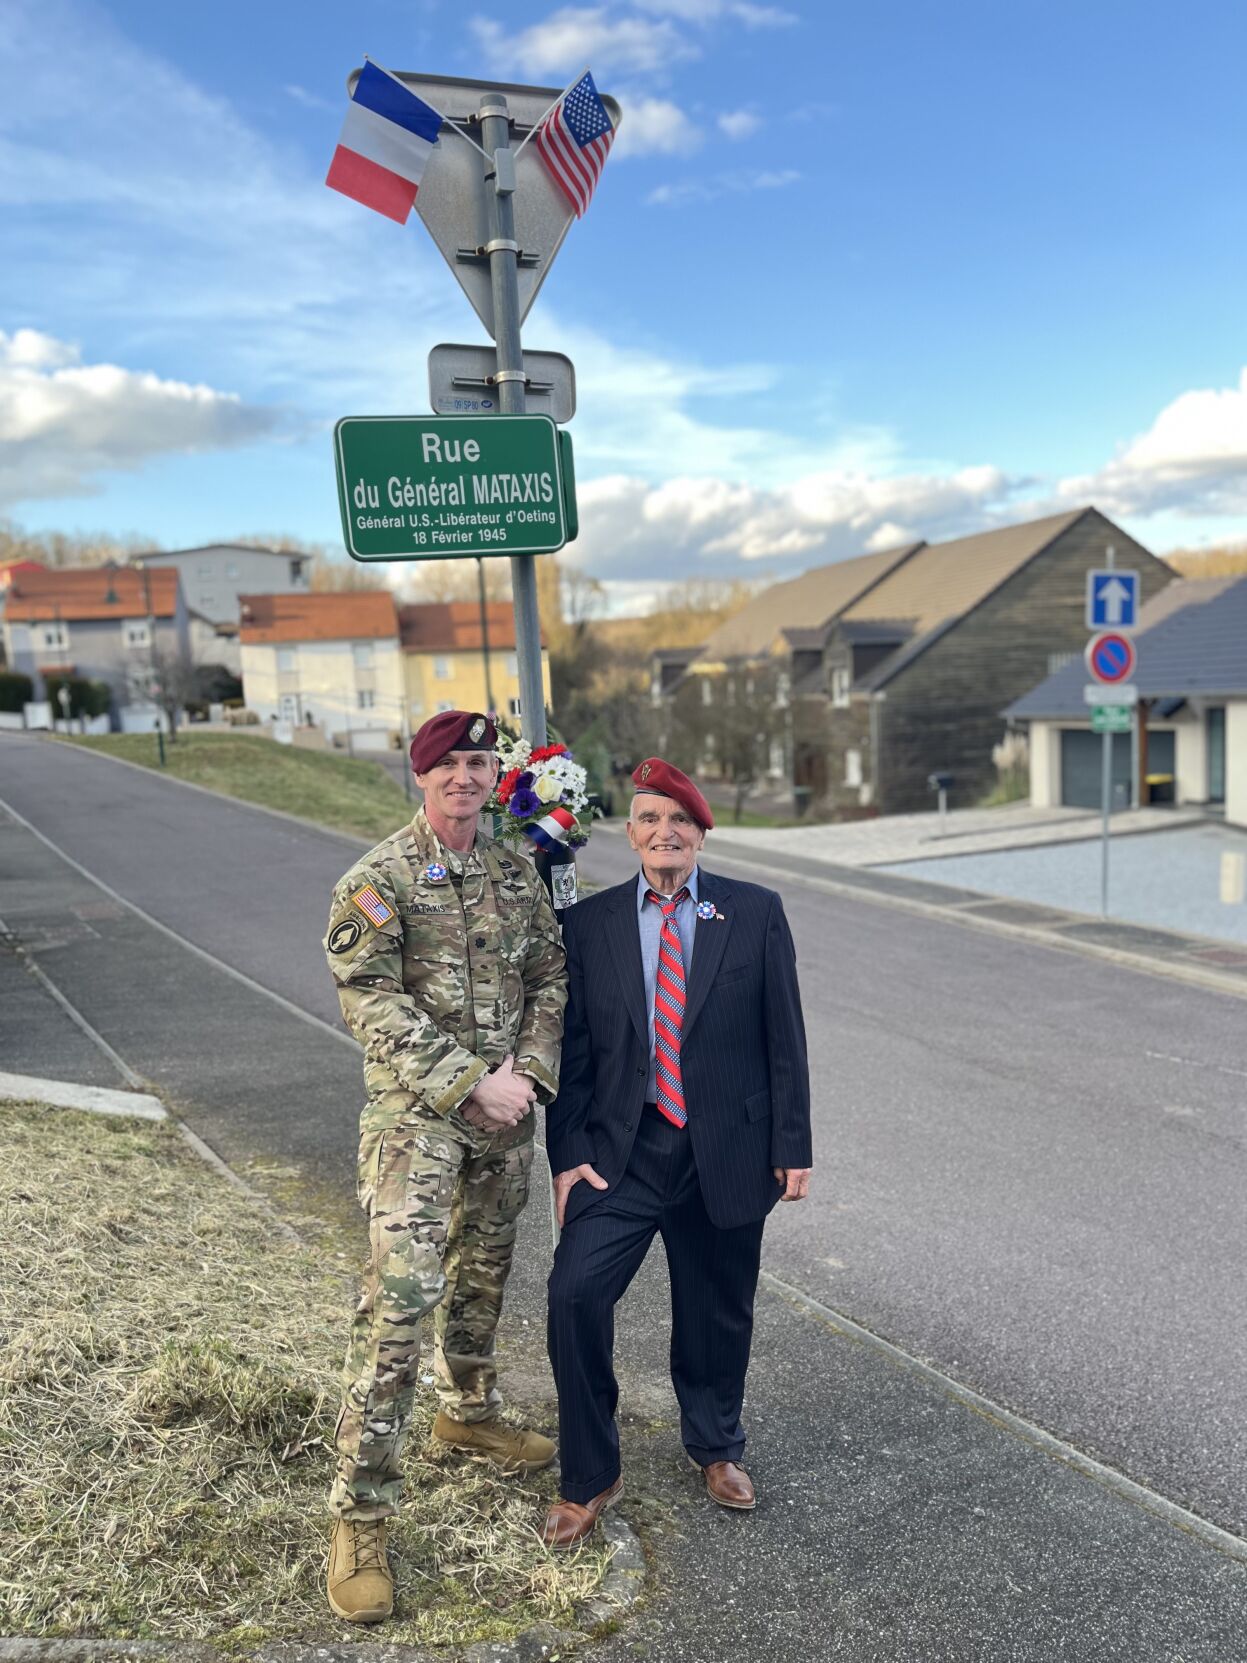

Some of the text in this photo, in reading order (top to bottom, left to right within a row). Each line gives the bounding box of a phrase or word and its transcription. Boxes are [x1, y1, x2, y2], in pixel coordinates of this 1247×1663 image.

[422, 432, 480, 463] Rue
[353, 473, 553, 509] du Général MATAXIS
[356, 514, 405, 530] Général
[505, 511, 556, 524] d'Oeting
[412, 528, 507, 545] 18 Février 1945
[406, 904, 446, 914] MATAXIS
